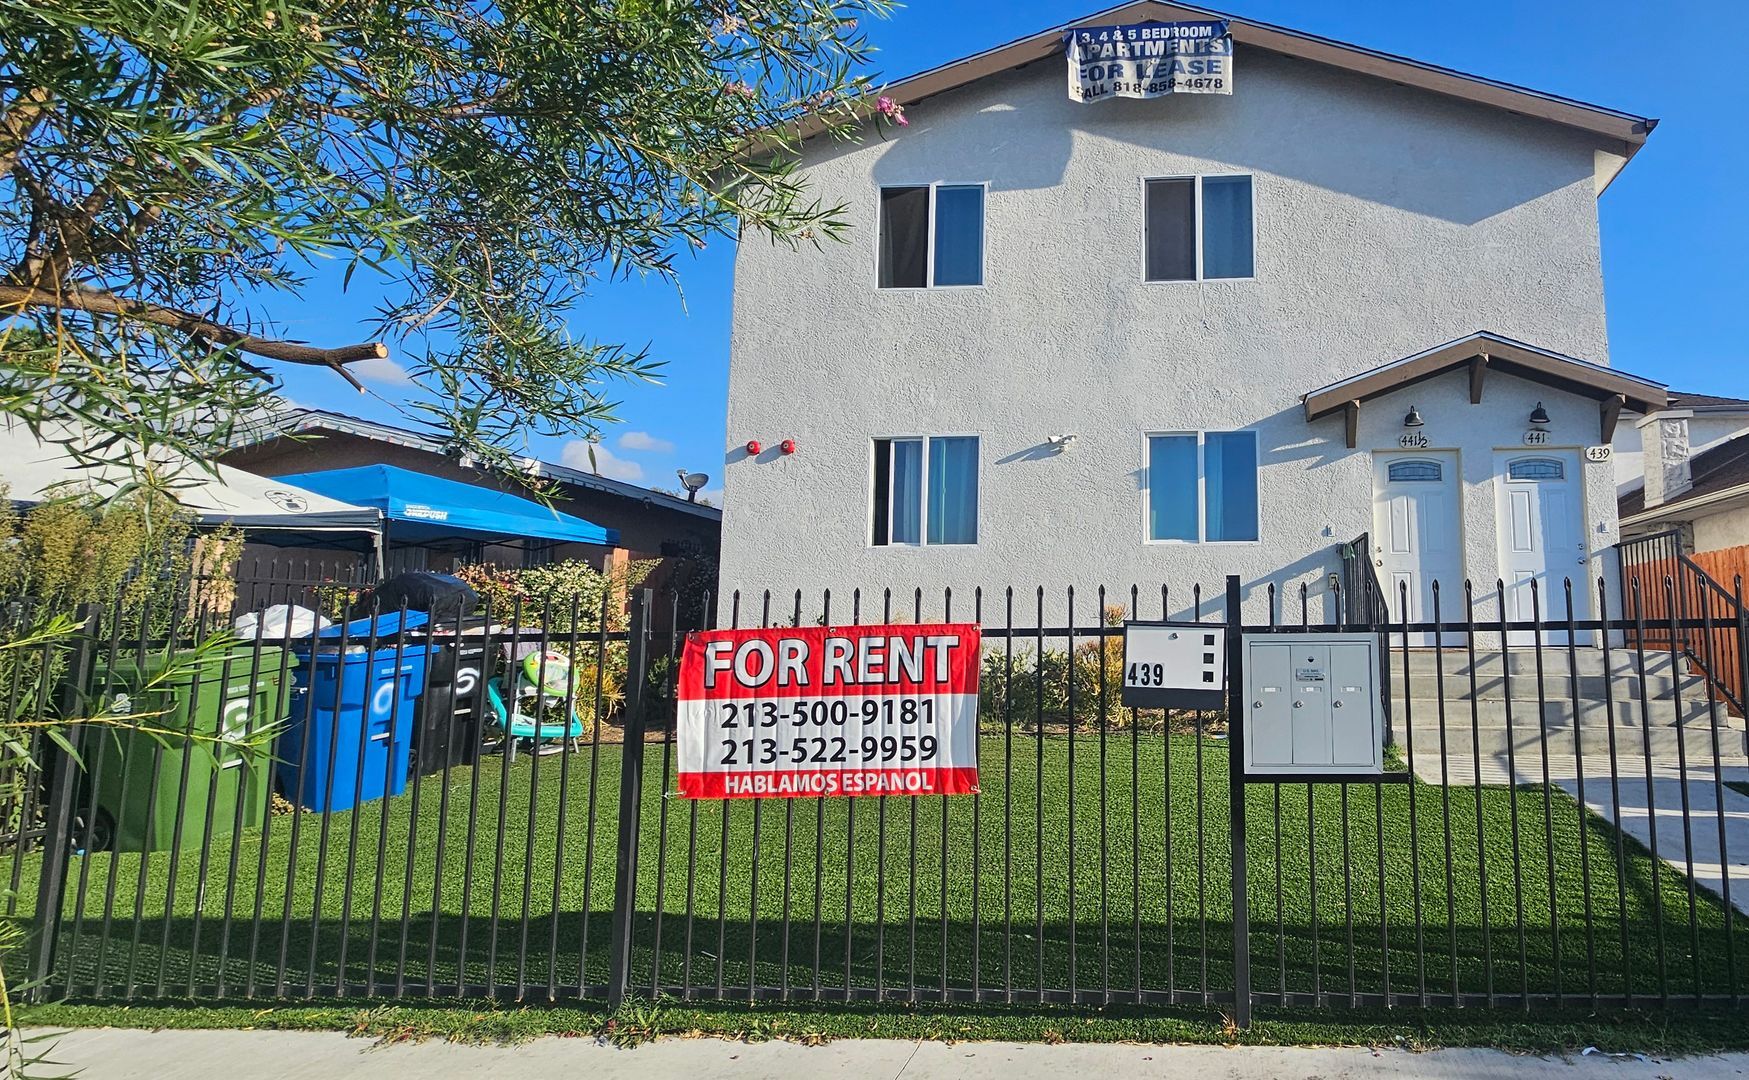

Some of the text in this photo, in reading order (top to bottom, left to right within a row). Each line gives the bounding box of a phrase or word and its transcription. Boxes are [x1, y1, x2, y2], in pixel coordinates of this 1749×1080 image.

[1082, 26, 1212, 44] 3, 4 & 5 BEDROOM
[1136, 59, 1222, 79] LEASE
[1113, 78, 1223, 94] 818-858-4678
[1528, 432, 1545, 444] 441
[1590, 448, 1610, 459] 439
[704, 635, 960, 688] FOR RENT
[1127, 663, 1164, 686] 439
[721, 699, 933, 728] 213-500-9181
[720, 735, 938, 765] 213-522-9959
[725, 772, 932, 794] HABLAMOS ESPANOL
